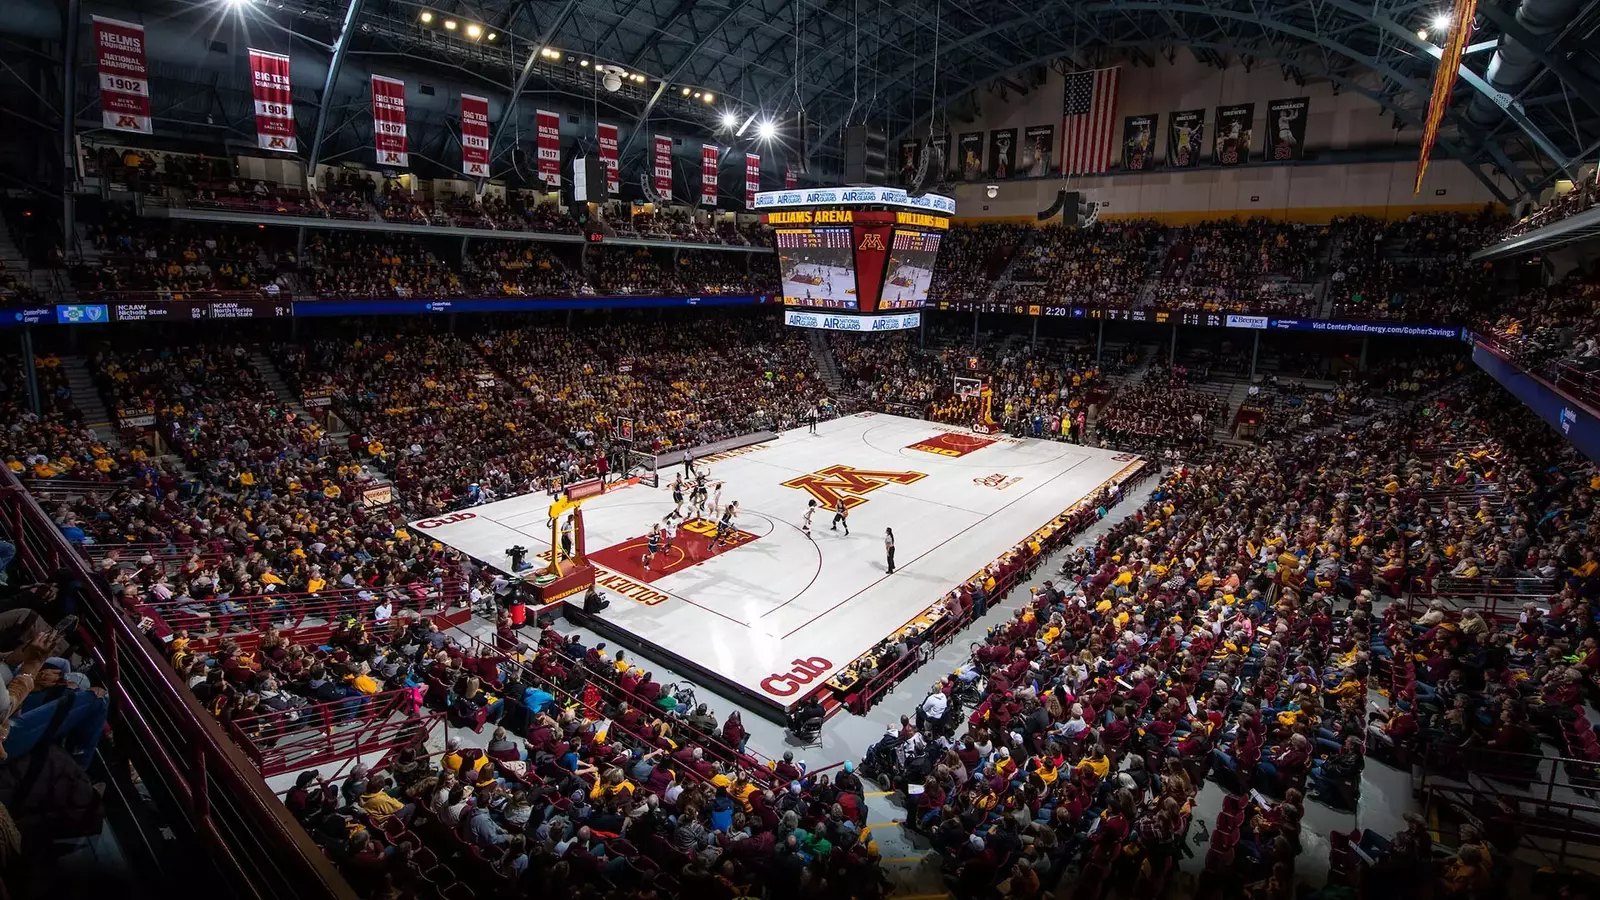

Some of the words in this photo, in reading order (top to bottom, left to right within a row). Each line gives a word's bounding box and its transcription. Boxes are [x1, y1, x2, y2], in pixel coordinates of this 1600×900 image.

[100, 31, 141, 48] HELMS
[100, 41, 142, 54] FOUNDATION
[104, 53, 141, 65] NATIONAL
[100, 59, 145, 72] CHAMPIONS
[254, 71, 270, 82] BIG
[272, 74, 289, 84] TEN
[108, 78, 141, 92] 1902
[255, 80, 290, 92] CHAMPIONS
[376, 94, 388, 104] BIG
[389, 97, 404, 106] TEN
[262, 104, 288, 116] 1906
[376, 102, 404, 112] CHAMPIONS
[464, 111, 474, 119] BIG
[476, 113, 487, 121] TEN
[464, 118, 488, 127] CHAMPIONS
[380, 123, 402, 134] 1907
[466, 137, 484, 146] 1911
[608, 138, 618, 146] TEN
[542, 150, 556, 158] 1917
[777, 195, 788, 204] AIR
[806, 194, 820, 202] AIR
[842, 192, 857, 201] AIR
[881, 192, 894, 201] AIR
[768, 212, 812, 224] WILLIAMS
[814, 210, 852, 222] ARENA
[898, 212, 934, 226] WILLIAMS
[860, 234, 885, 250] M
[1014, 306, 1023, 314] 16
[1045, 306, 1066, 316] 2:20
[1091, 310, 1101, 318] 11
[24, 316, 38, 324] Energy
[789, 315, 800, 325] AIR
[823, 318, 840, 328] AIR
[872, 320, 886, 330] AIR
[902, 318, 911, 328] AIR
[1238, 316, 1264, 324] Bremer
[1312, 322, 1326, 331] Visit
[1326, 324, 1456, 340] CenterPointEnergy.com/GopherSavings
[973, 424, 989, 434] Cub
[416, 512, 477, 528] Cub
[597, 575, 669, 606] GOLDEN
[760, 656, 833, 696] Cub
